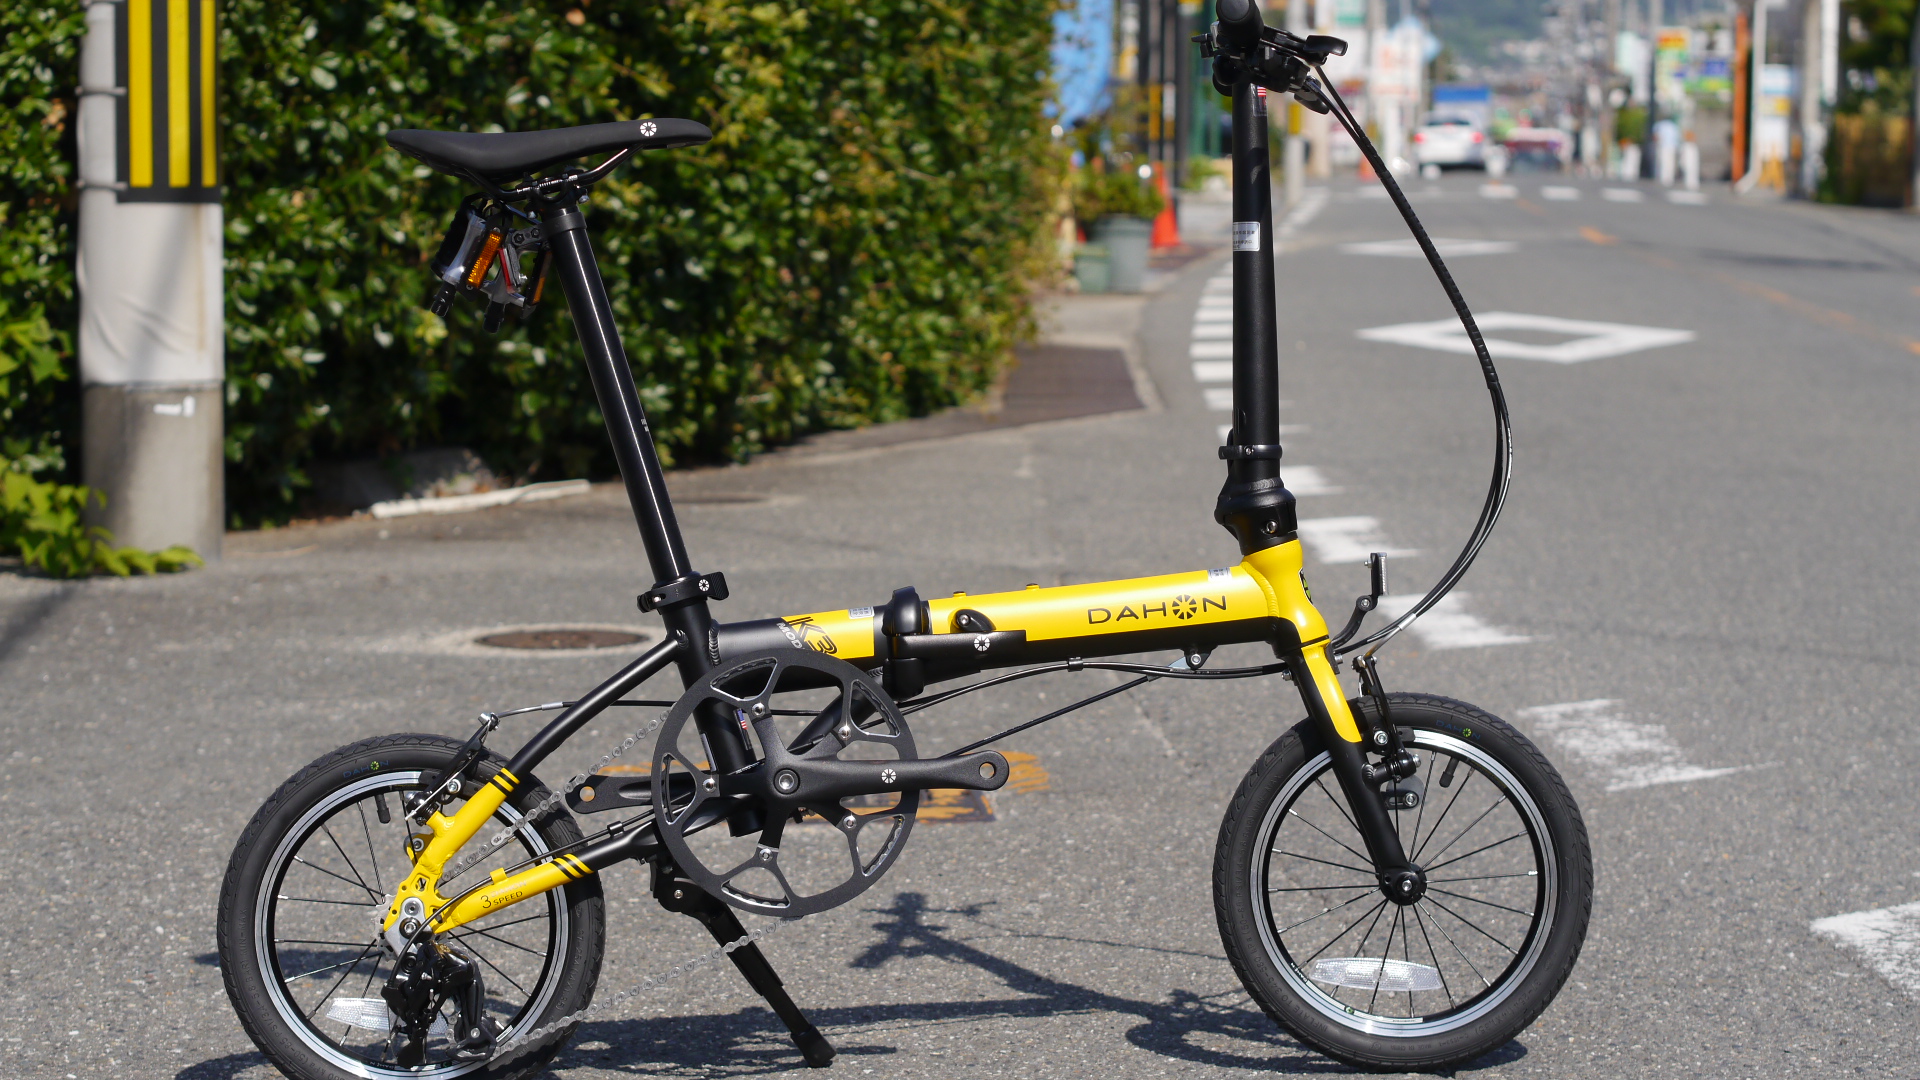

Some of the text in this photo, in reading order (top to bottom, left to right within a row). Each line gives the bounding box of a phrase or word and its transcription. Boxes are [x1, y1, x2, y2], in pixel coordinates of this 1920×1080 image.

[1088, 594, 1227, 625] DAHON
[776, 622, 806, 650] MOD
[1436, 720, 1481, 740] DAHON
[343, 760, 389, 778] DAHON
[480, 891, 523, 909] 3 SPEED
[1279, 993, 1293, 1007] TO
[1291, 1004, 1328, 1033] INFLATE
